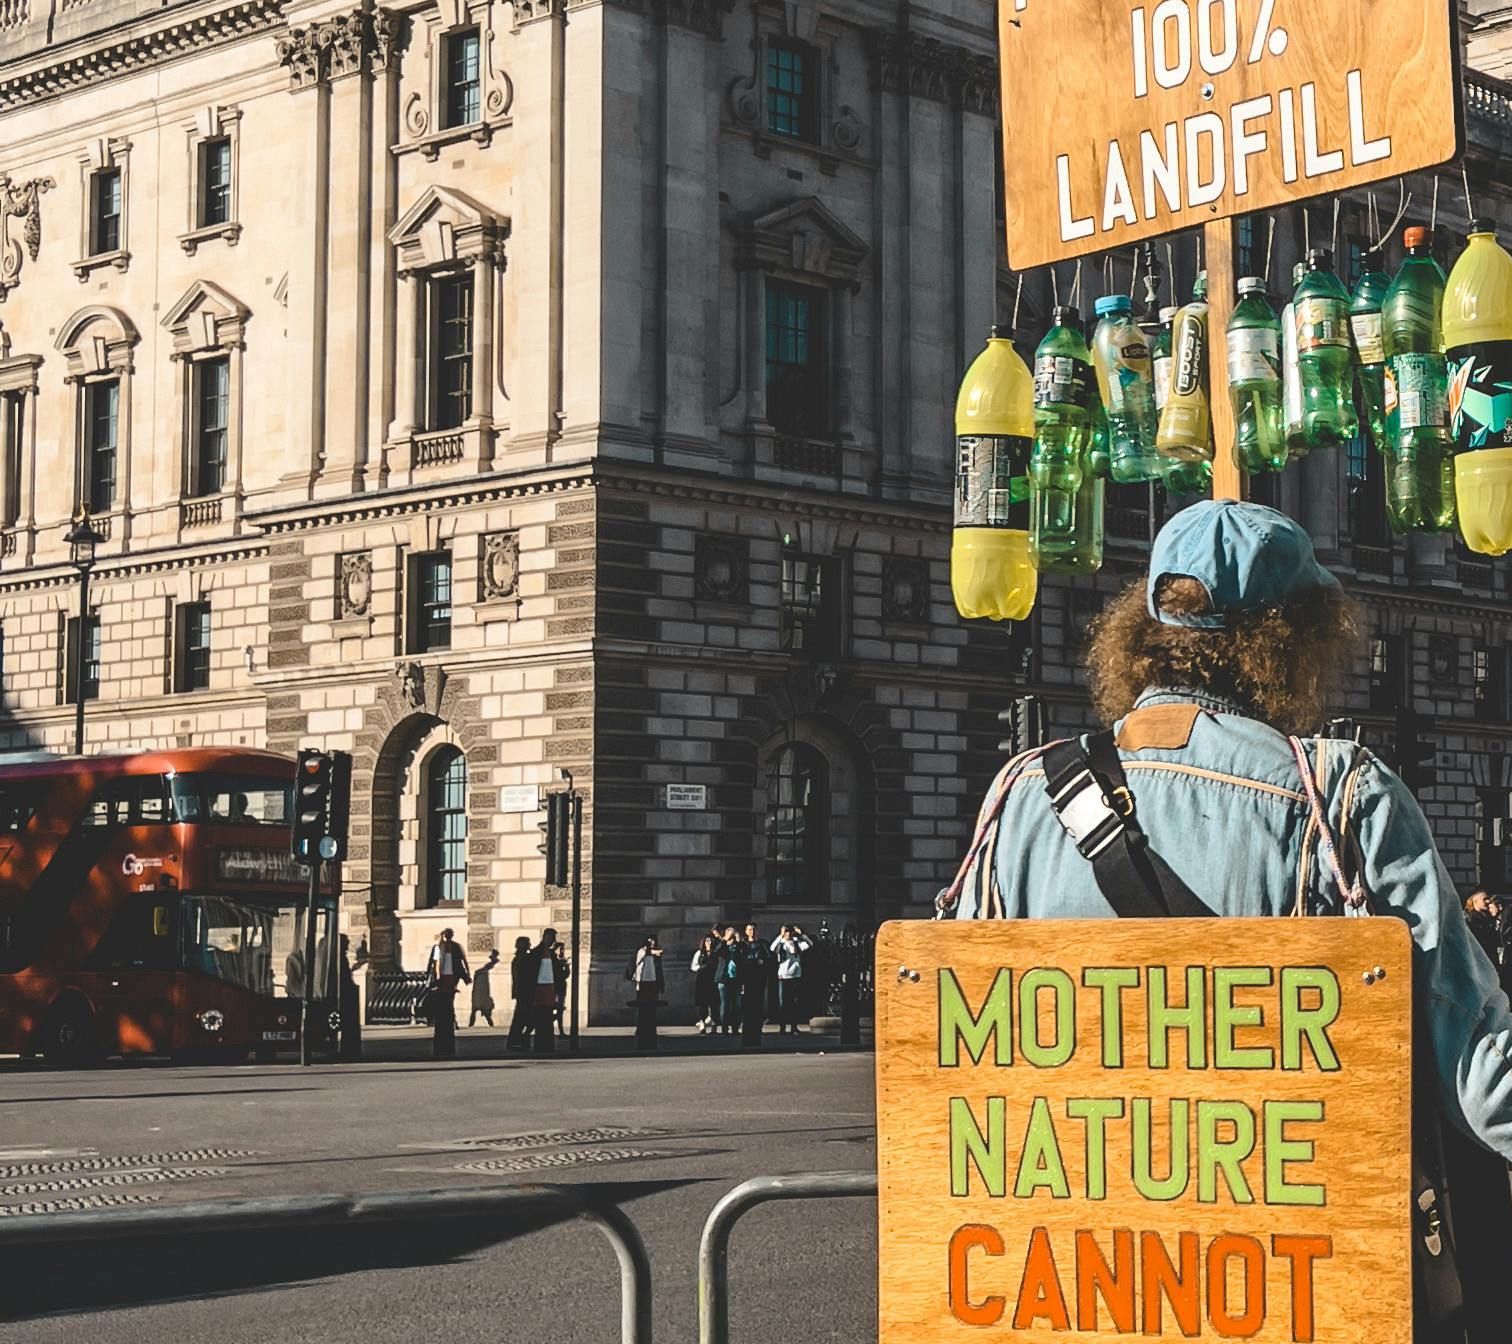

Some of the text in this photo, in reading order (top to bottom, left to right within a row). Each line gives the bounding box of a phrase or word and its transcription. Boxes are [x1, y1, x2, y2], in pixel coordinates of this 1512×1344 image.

[1055, 69, 1393, 244] LANDFILL
[1179, 330, 1197, 389] BOOST
[937, 965, 1342, 1074] MOTHER
[948, 1096, 1327, 1206] NATURE
[948, 1223, 1334, 1343] CANNOT
